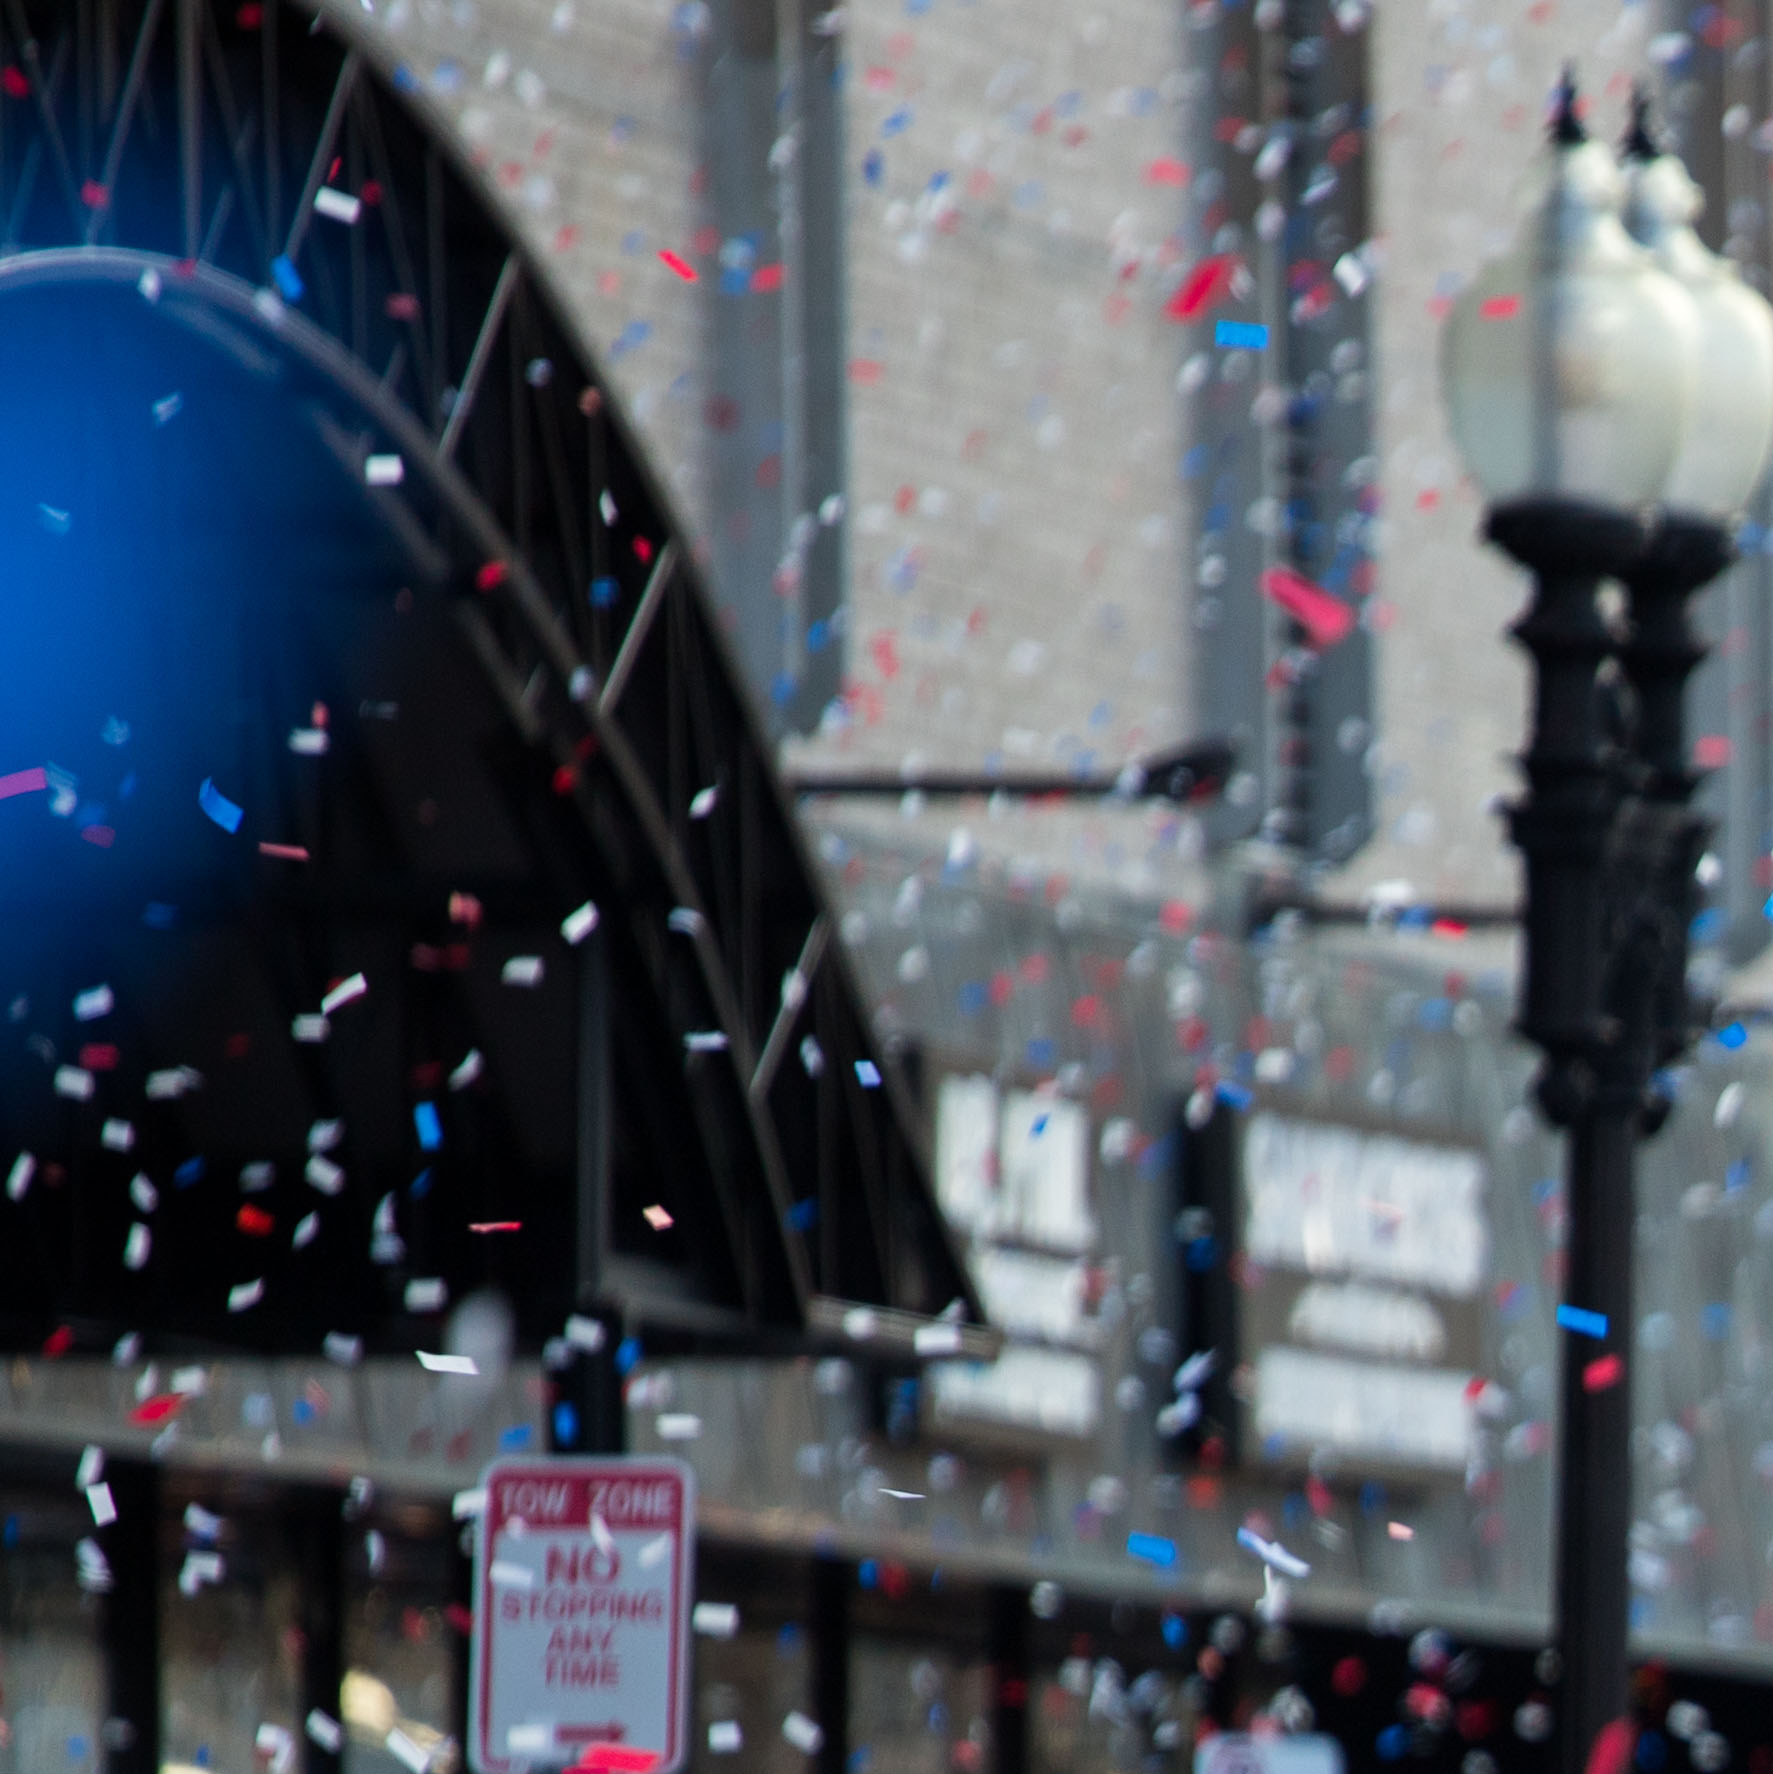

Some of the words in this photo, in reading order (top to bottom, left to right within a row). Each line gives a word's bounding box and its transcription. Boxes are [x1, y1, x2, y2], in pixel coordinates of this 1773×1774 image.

[502, 1480, 569, 1522] TOW
[588, 1480, 676, 1522] ZONE
[544, 1542, 621, 1586] NO
[502, 1588, 663, 1624] STOPPING
[546, 1624, 614, 1655] ANY
[545, 1655, 620, 1688] TIME
